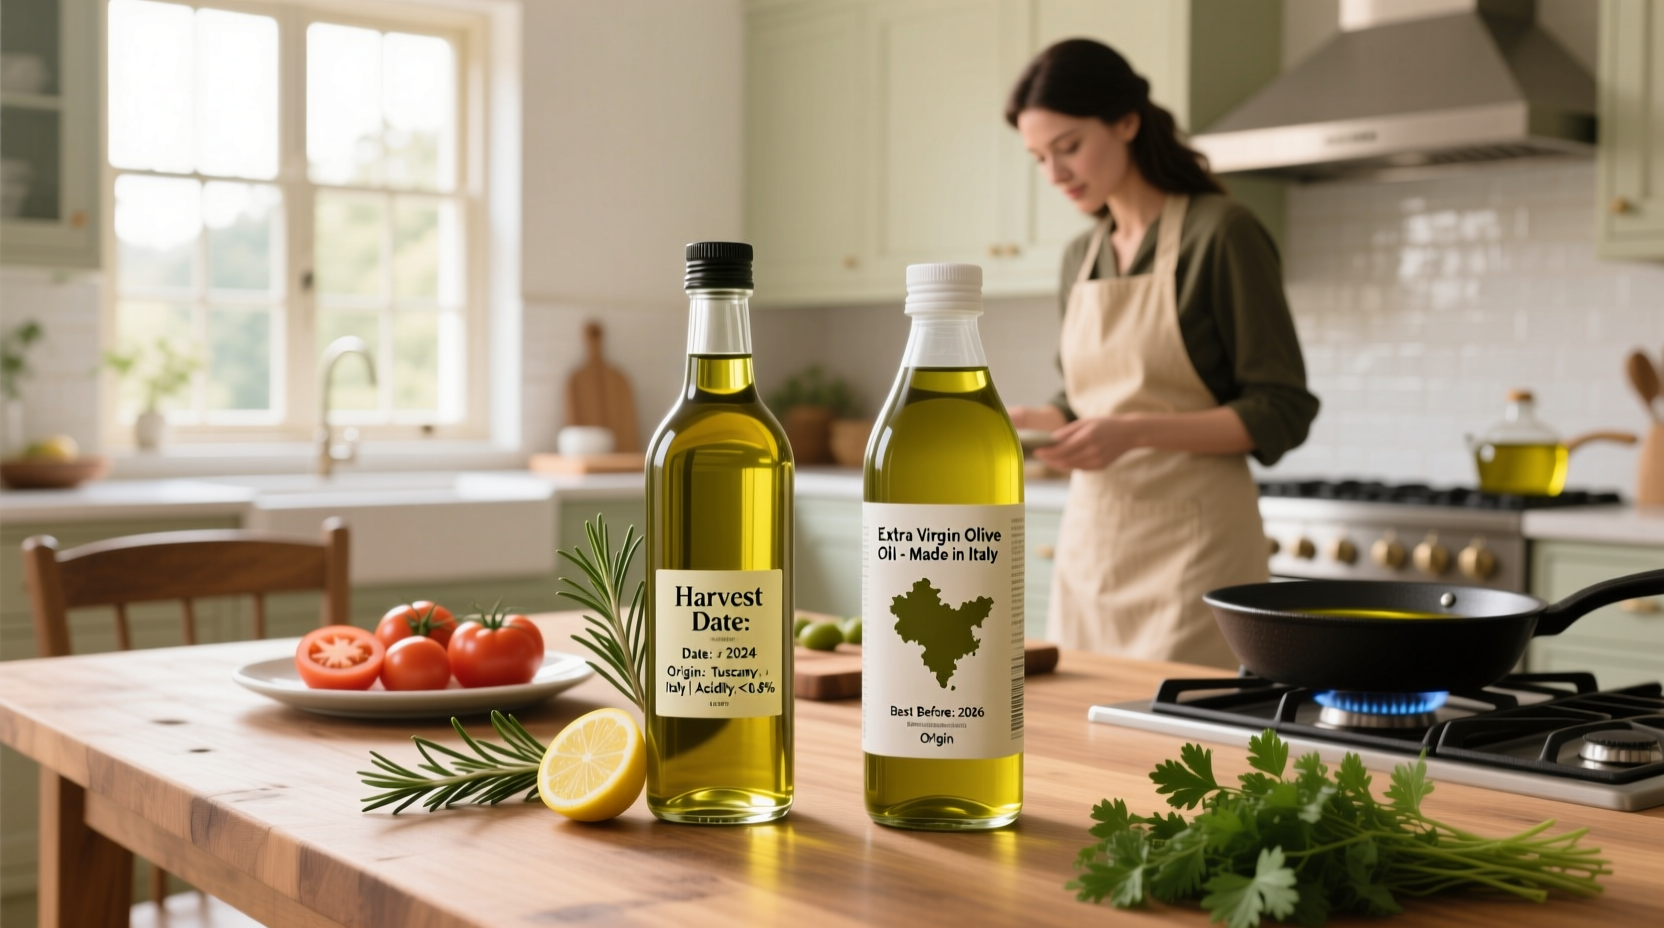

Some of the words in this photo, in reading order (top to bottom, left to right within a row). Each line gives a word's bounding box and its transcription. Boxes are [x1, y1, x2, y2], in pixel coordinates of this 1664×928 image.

[878, 527, 913, 542] Extra
[916, 528, 961, 546] Virgin
[964, 527, 1002, 542] Olive
[878, 546, 897, 561] Oil
[909, 546, 949, 561] Made
[952, 547, 965, 561] in
[969, 546, 999, 564] Italy
[675, 586, 763, 607] Harvest
[692, 611, 750, 631] Date:
[682, 647, 713, 660] Date:
[726, 647, 757, 659] 2024
[890, 705, 914, 717] Best
[917, 705, 955, 718] Before:
[957, 706, 985, 718] 2026
